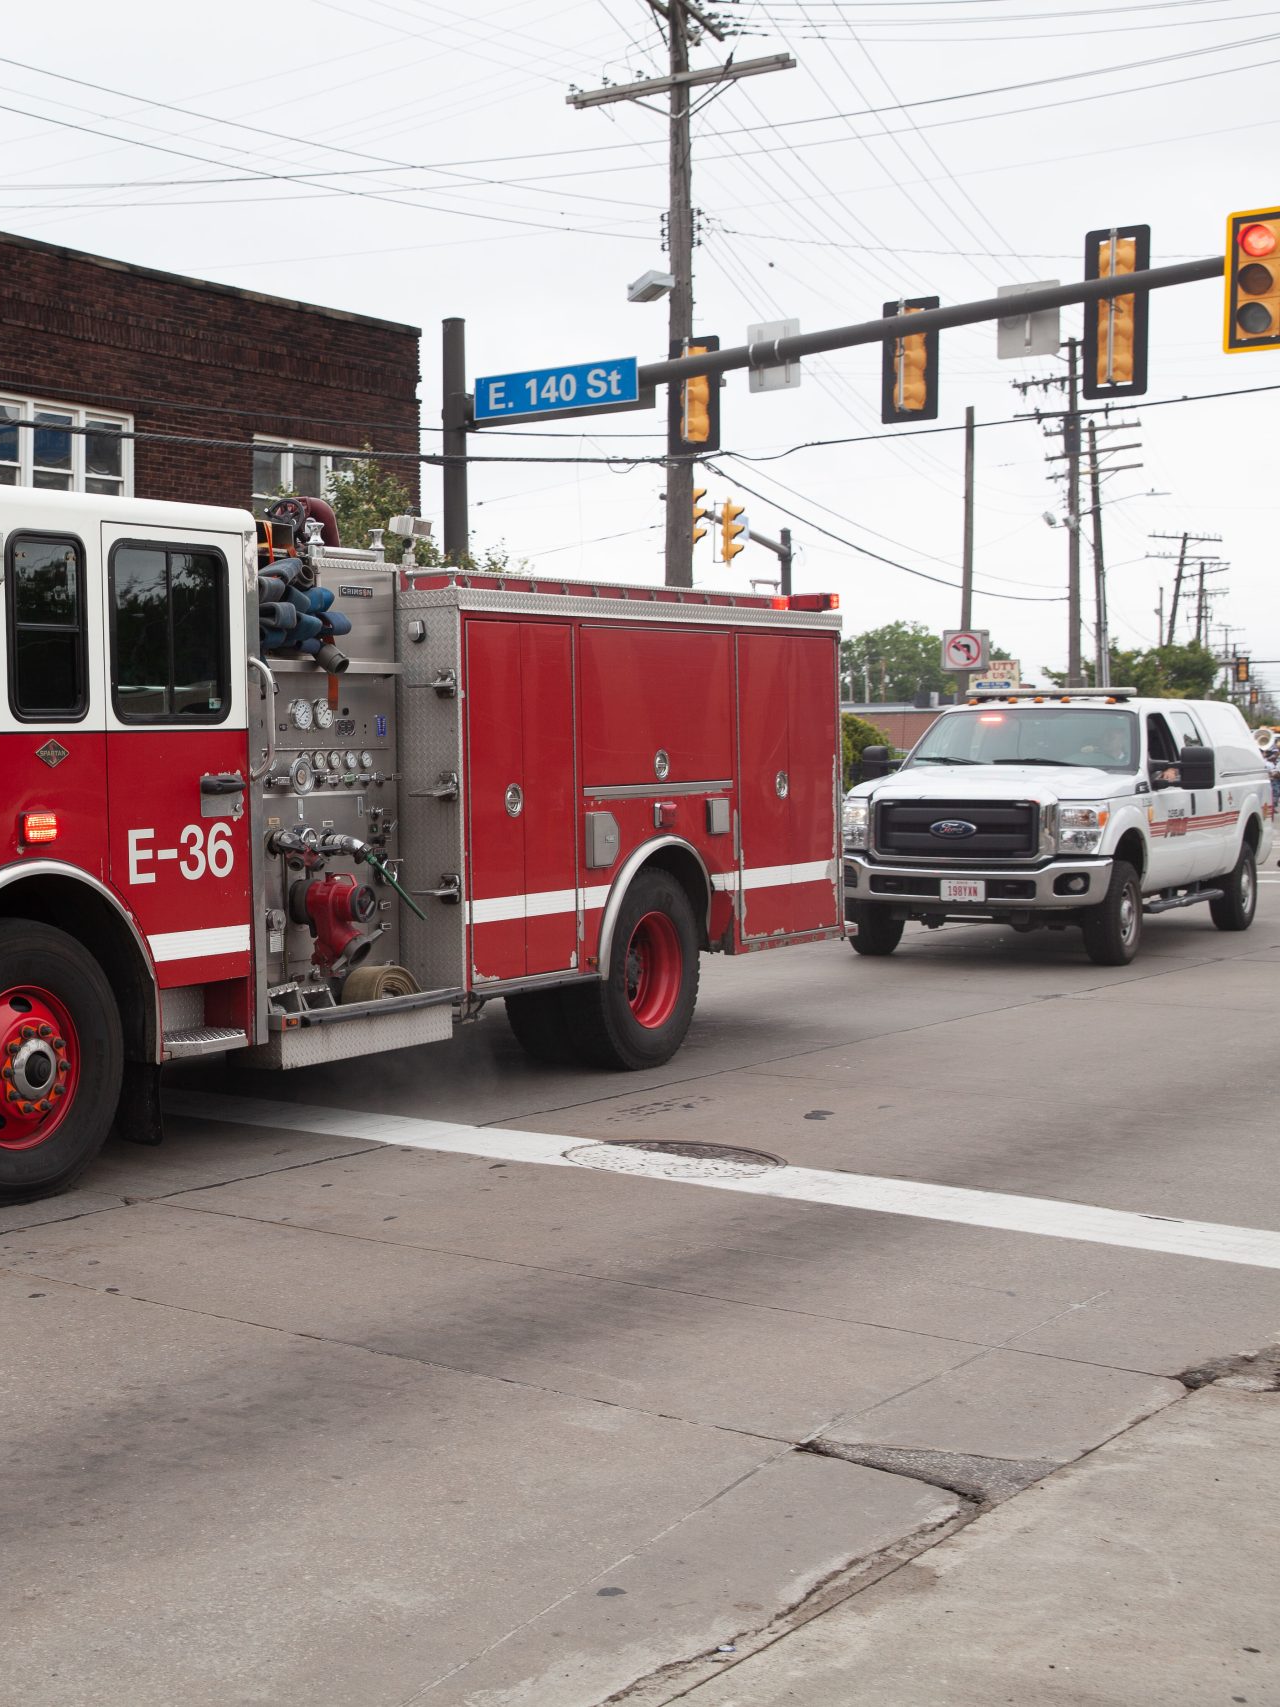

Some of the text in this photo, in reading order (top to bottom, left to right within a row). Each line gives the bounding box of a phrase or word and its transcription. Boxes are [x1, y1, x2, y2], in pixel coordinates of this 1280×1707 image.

[488, 368, 621, 411] E. 140 St
[127, 822, 234, 885] E-36
